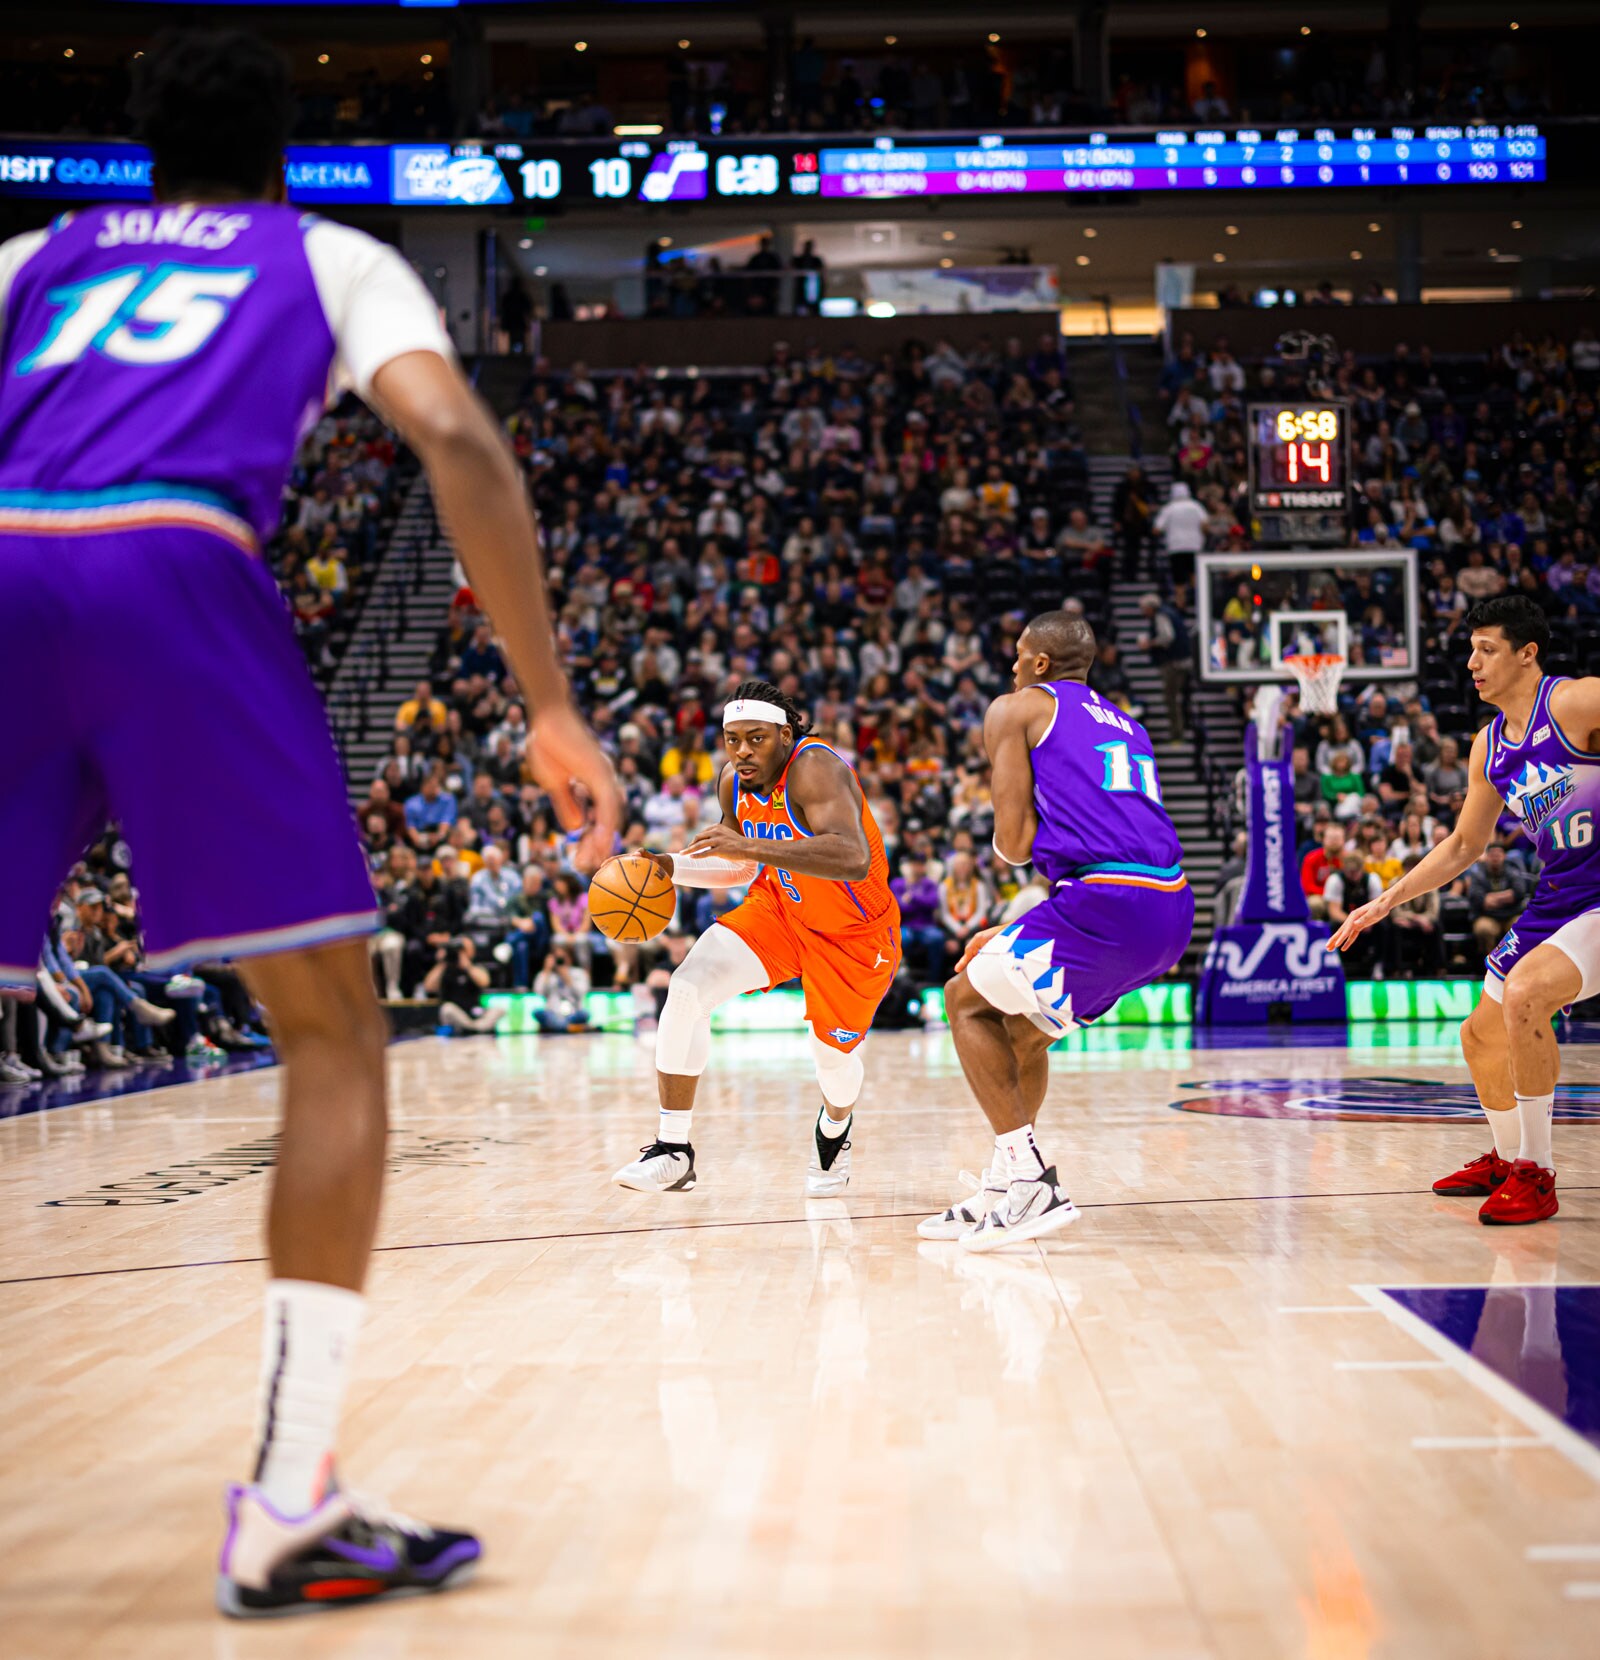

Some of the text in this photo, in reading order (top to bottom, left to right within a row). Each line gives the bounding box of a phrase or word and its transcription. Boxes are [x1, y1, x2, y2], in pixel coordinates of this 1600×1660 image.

[0, 157, 55, 182] ISIT
[1164, 147, 1178, 164] 3
[1203, 147, 1217, 162] 4
[1242, 146, 1255, 161] 7
[1280, 145, 1294, 162] 2
[1318, 144, 1332, 161] 0
[1356, 144, 1371, 160] 0
[1395, 143, 1410, 160] 0
[1437, 142, 1451, 159] 0
[1471, 142, 1495, 158] 101
[1507, 141, 1536, 157] 100
[519, 160, 561, 199] 10
[588, 158, 631, 197] 10
[1167, 168, 1178, 186] 1
[1318, 165, 1334, 183] 0
[1360, 164, 1370, 182] 1
[1399, 163, 1408, 181] 1
[1436, 162, 1451, 181] 0
[1467, 162, 1498, 180] 100
[1508, 161, 1534, 179] 101
[96, 203, 251, 250] JONES
[15, 261, 258, 378] 15
[1277, 410, 1337, 441] 6:58
[1288, 442, 1329, 482] 14
[1281, 491, 1344, 507] TISSOT
[1093, 740, 1164, 808] 11
[1262, 766, 1285, 913] AMERICA FIRST
[1544, 808, 1594, 851] 16
[775, 867, 802, 903] 5
[1220, 976, 1336, 997] AMERICA FIRST
[36, 1169, 264, 1209] arena
